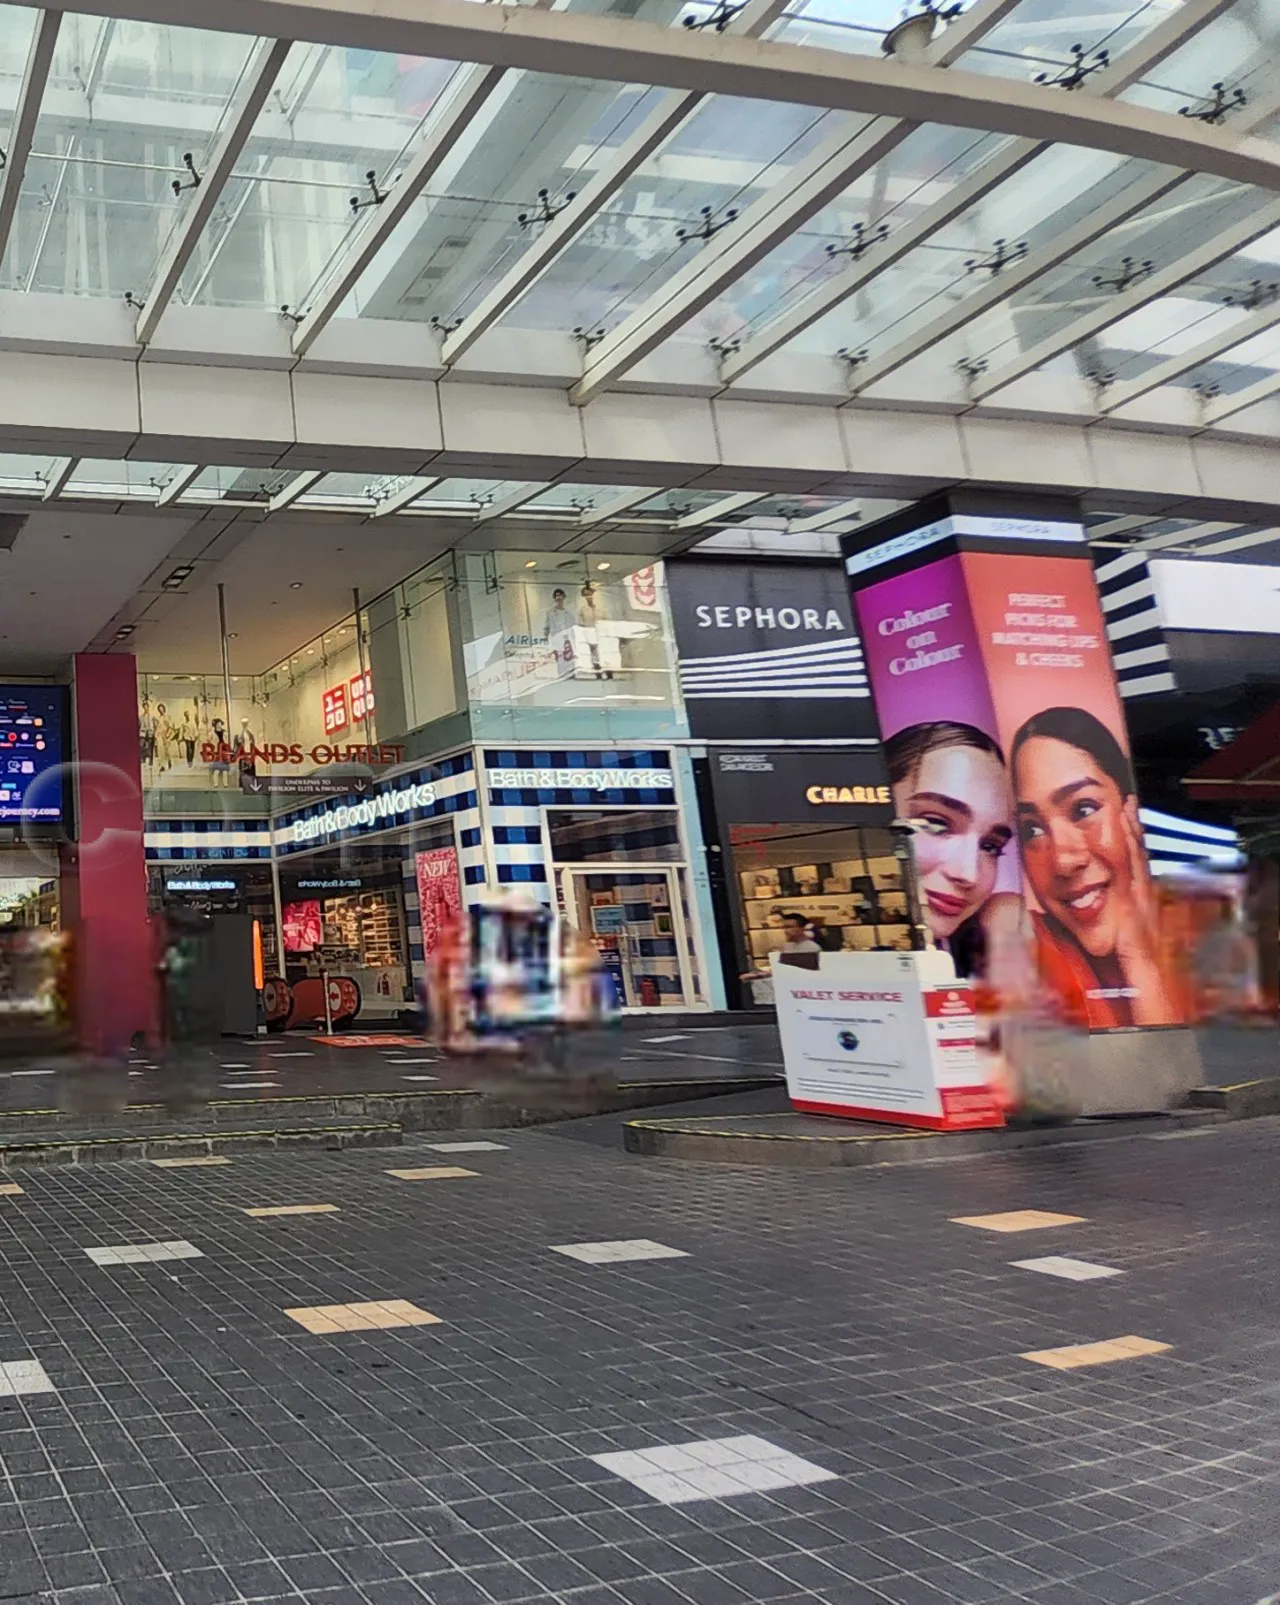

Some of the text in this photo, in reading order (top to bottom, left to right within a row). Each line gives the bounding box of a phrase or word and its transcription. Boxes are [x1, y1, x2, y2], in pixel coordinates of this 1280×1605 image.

[696, 605, 845, 632] SEPHORA
[200, 742, 406, 766] BRANDS OUTLET
[489, 770, 673, 791] Bath & Body Works
[293, 784, 436, 842] Bath & Body Works
[790, 990, 904, 1003] VALET SERVICE
